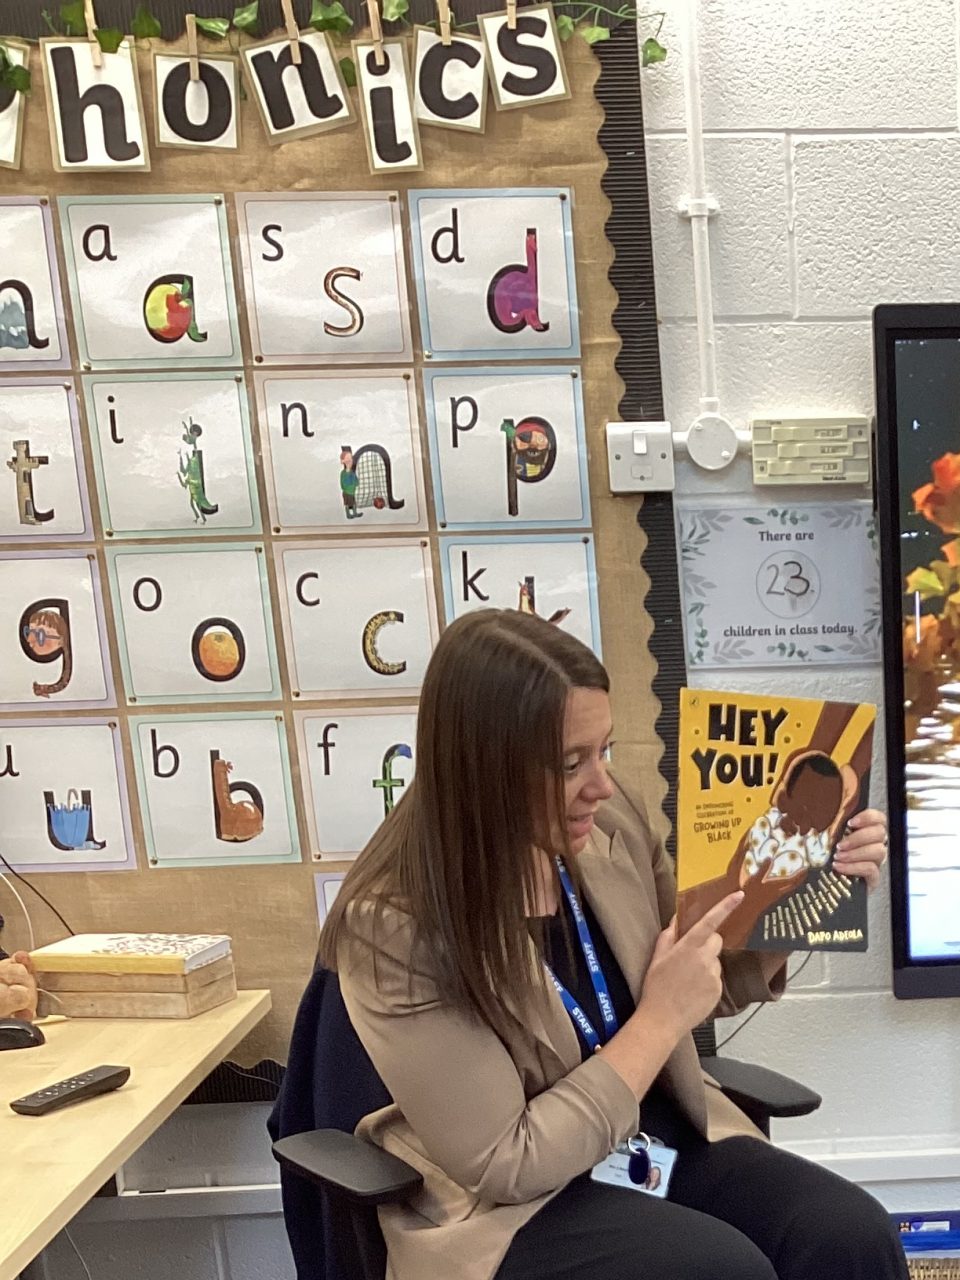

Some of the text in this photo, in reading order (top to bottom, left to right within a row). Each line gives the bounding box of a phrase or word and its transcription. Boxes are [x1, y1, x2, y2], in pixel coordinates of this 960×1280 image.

[0, 14, 558, 164] honics
[82, 224, 118, 262] a
[261, 224, 285, 262] s
[430, 208, 465, 264] d
[487, 228, 550, 334] d
[143, 274, 208, 344] a
[107, 396, 124, 444] i
[280, 402, 315, 438] n
[449, 396, 478, 448] p
[7, 440, 55, 524] t
[340, 444, 405, 514] n
[501, 416, 557, 517] p
[758, 531, 815, 542] There are
[132, 576, 163, 612] o
[295, 571, 321, 607] c
[462, 550, 490, 602] k
[19, 598, 73, 699] g
[191, 617, 246, 682] o
[723, 623, 858, 637] children in class today.
[317, 723, 340, 776] f
[707, 702, 789, 747] HEY
[150, 728, 180, 778] b
[690, 747, 780, 791] YOU!
[43, 788, 107, 851] u
[209, 749, 264, 843] b
[693, 817, 742, 833] GROWING UP
[706, 830, 732, 843] BLACK
[572, 1006, 593, 1035] STAFF
[598, 991, 614, 1022] STAFF
